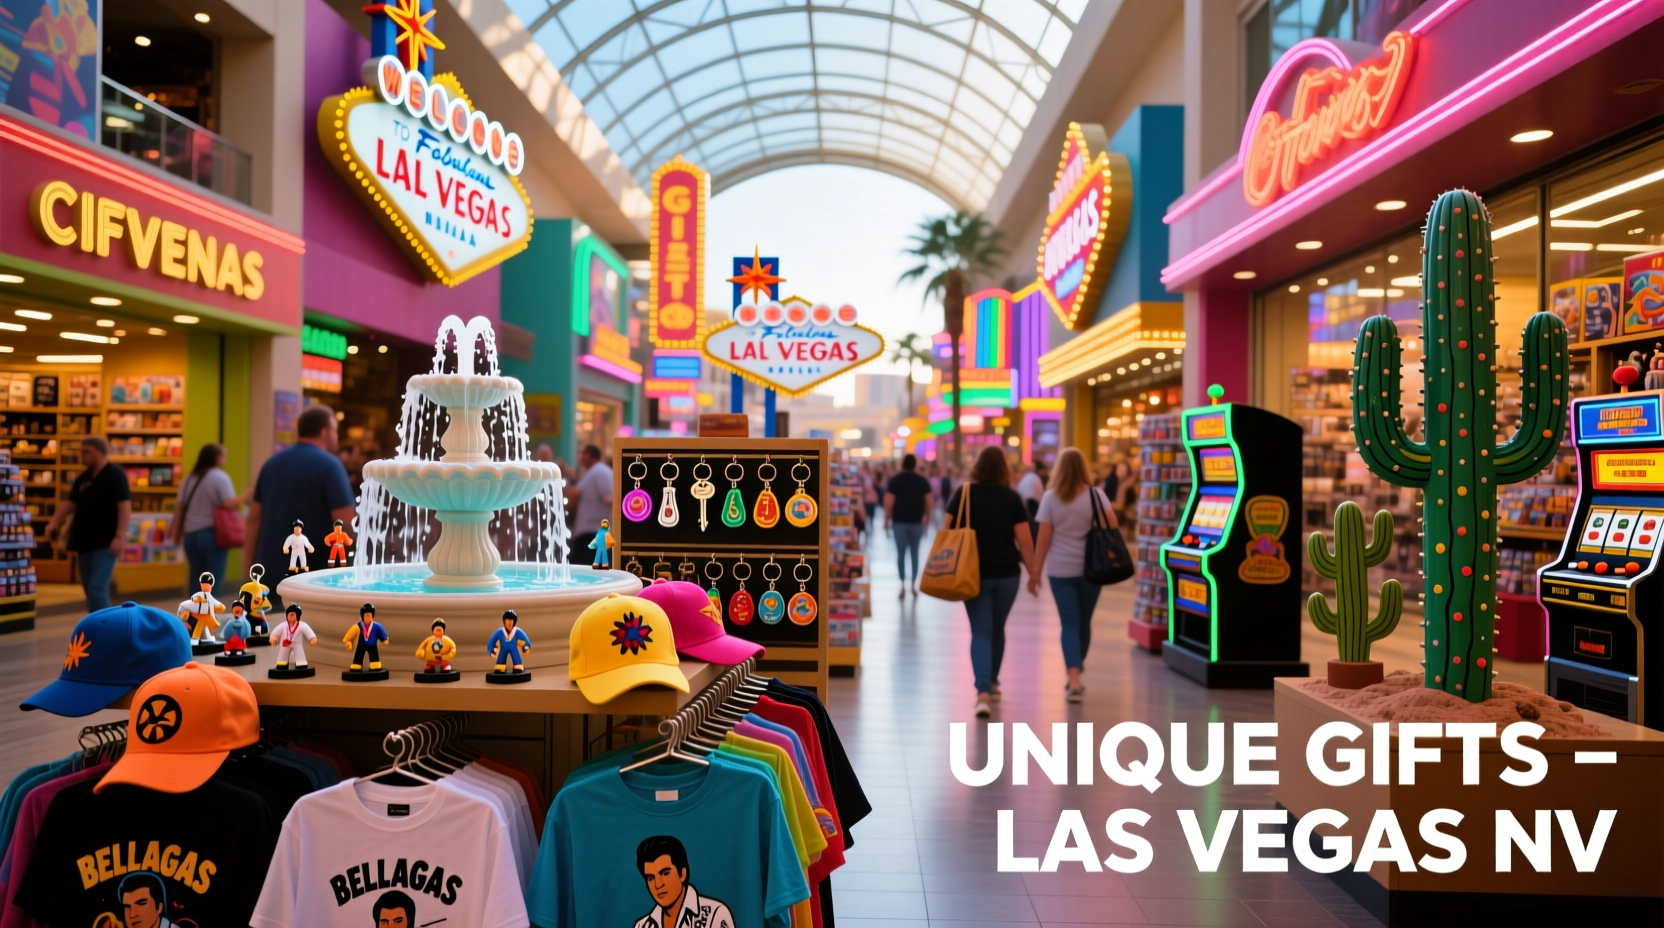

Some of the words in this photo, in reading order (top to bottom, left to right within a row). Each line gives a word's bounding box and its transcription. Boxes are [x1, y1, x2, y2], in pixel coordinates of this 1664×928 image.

[376, 136, 428, 200] LAL
[435, 168, 512, 239] VEGAS
[38, 180, 265, 301] CIFVENAS
[729, 341, 770, 361] LAL
[777, 341, 859, 361] VEGAS
[76, 841, 217, 894] BELLAGAS
[329, 858, 463, 907] BELLAGAS
